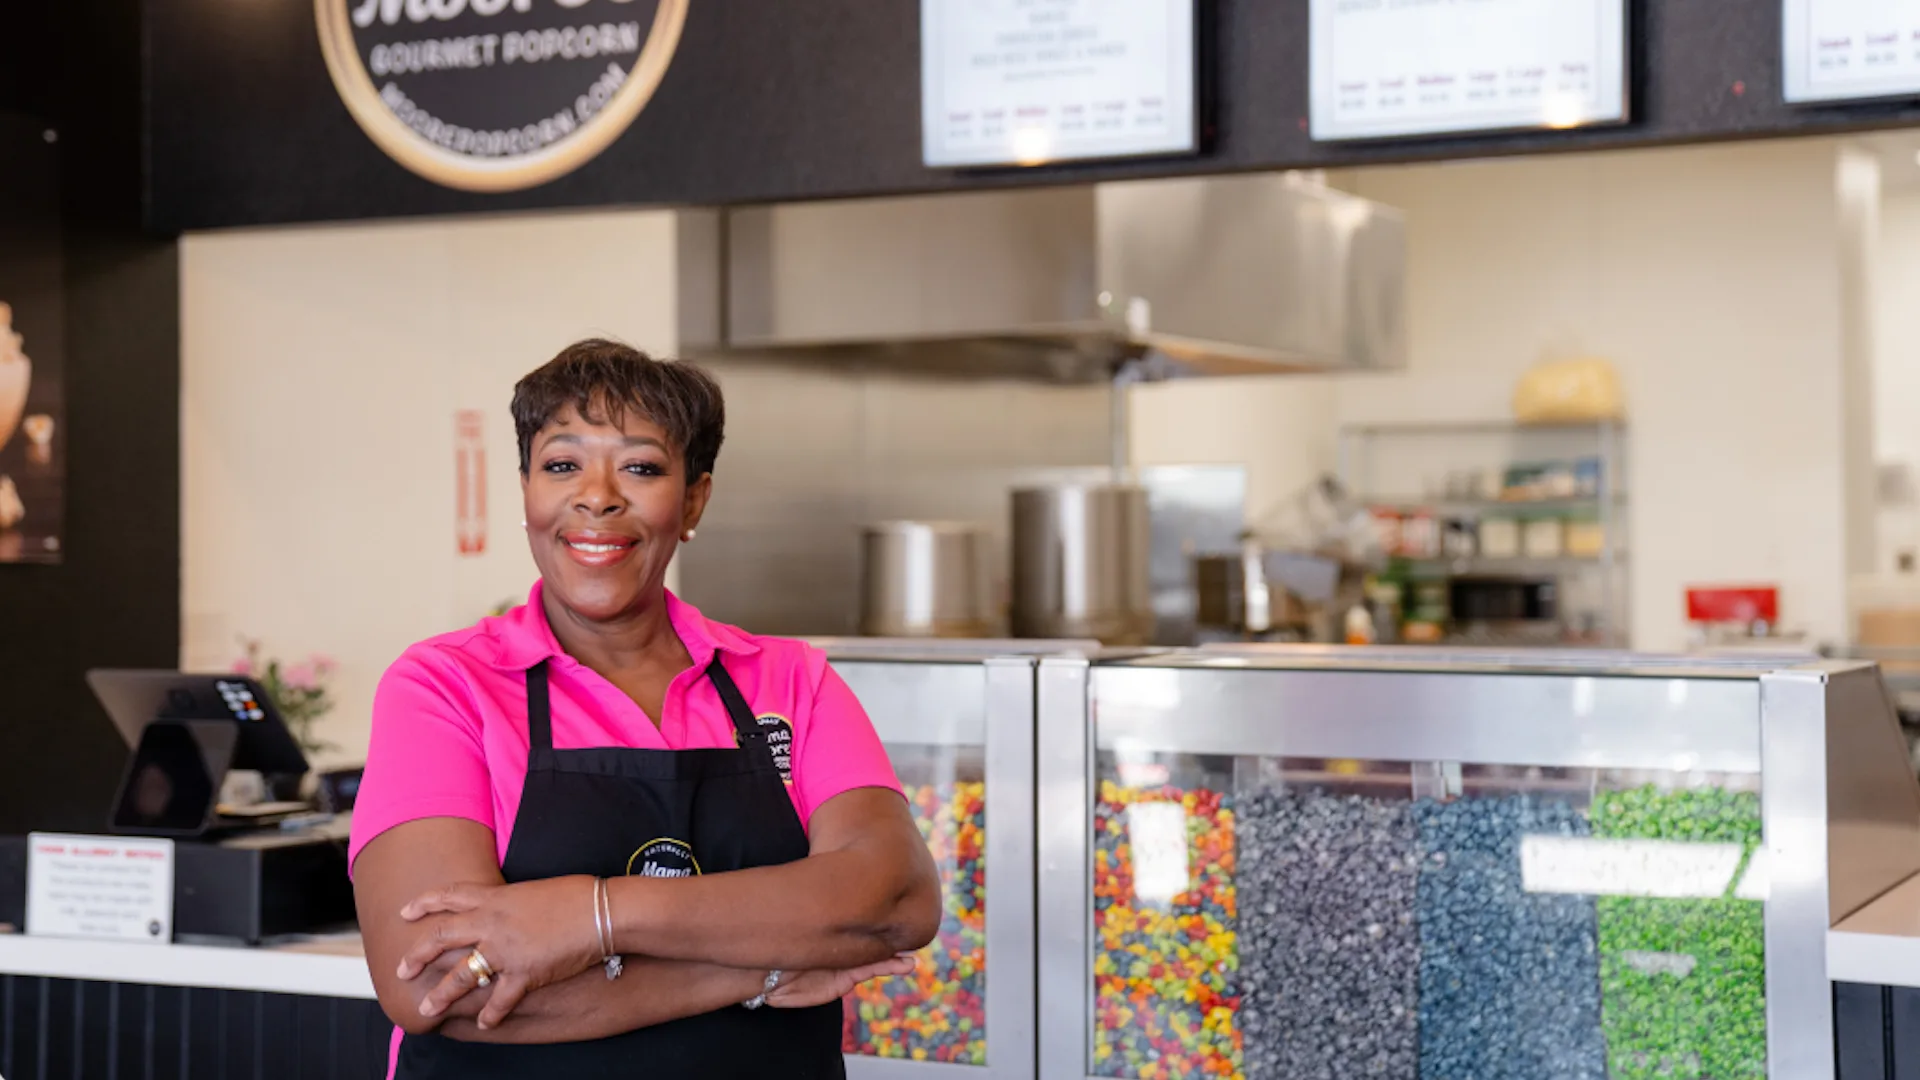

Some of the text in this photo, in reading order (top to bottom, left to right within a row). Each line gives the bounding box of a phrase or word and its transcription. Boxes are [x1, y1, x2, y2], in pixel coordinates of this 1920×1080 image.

[370, 21, 639, 76] GOURMET POPCORN
[640, 861, 692, 878] Mama
